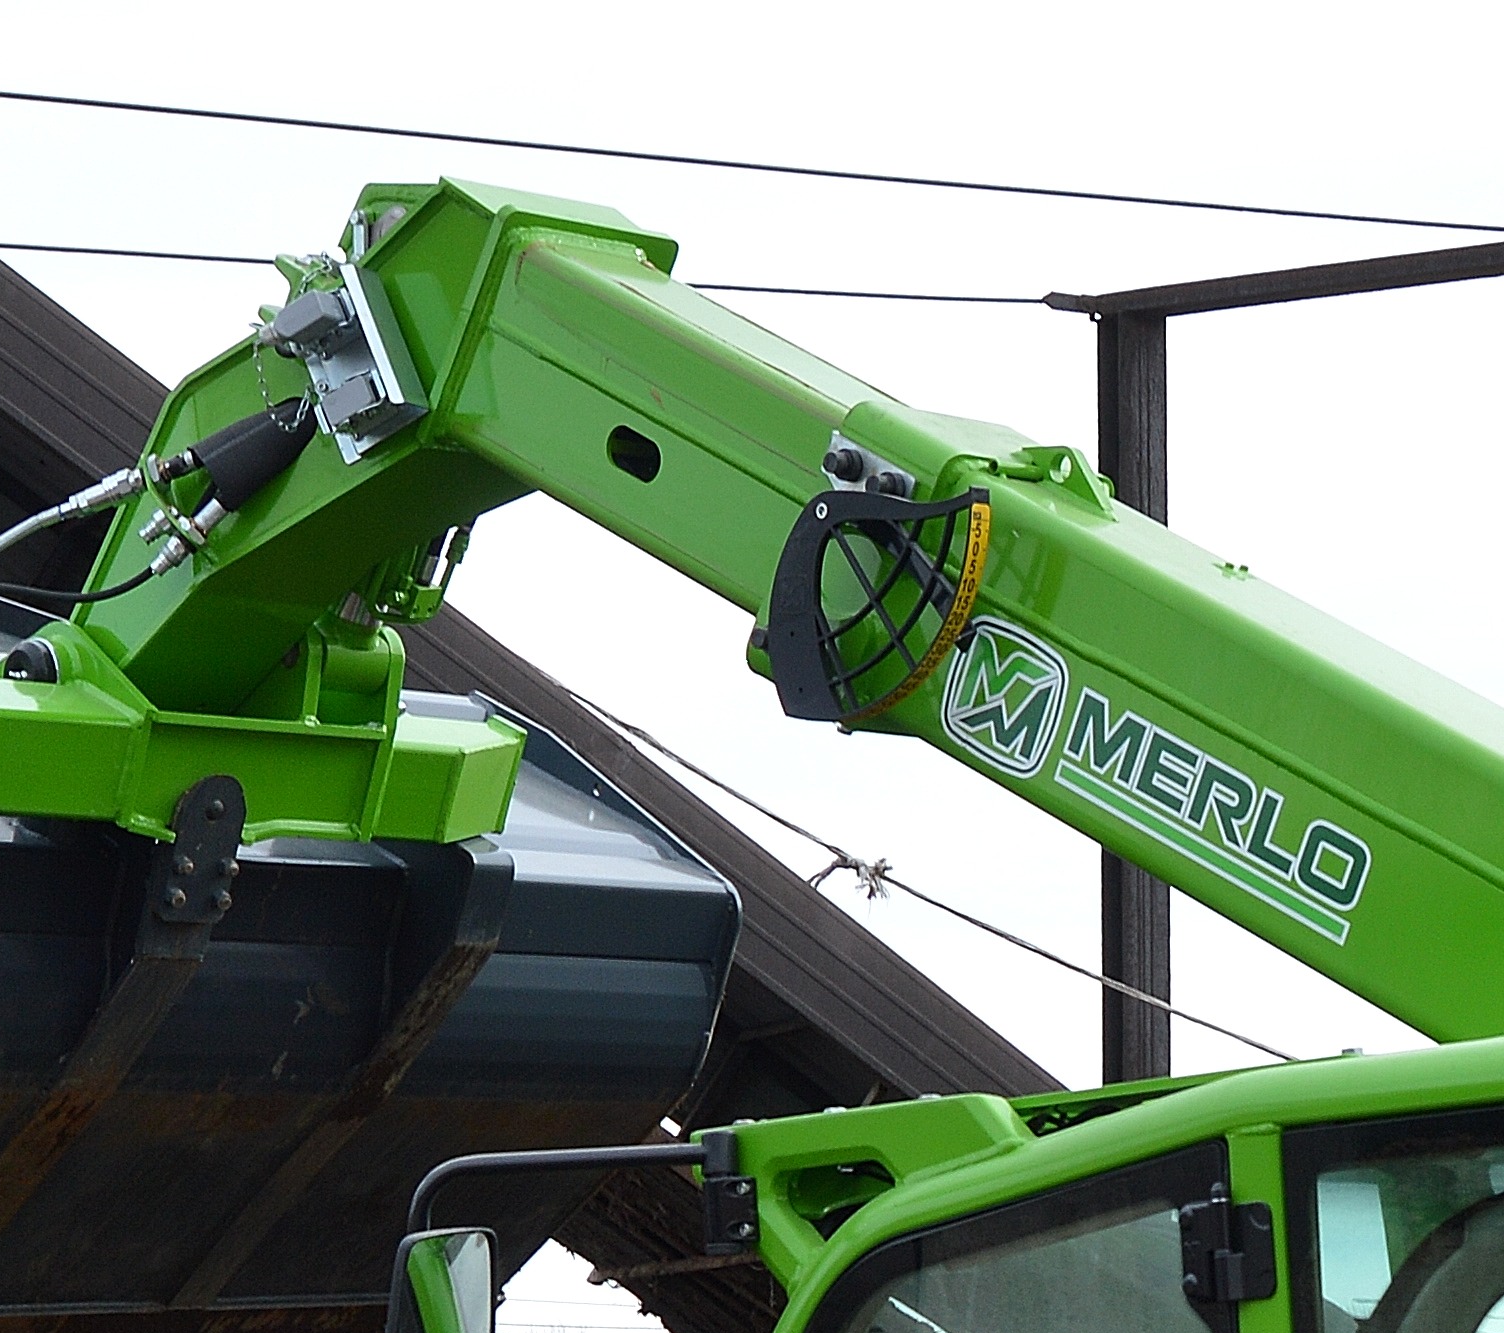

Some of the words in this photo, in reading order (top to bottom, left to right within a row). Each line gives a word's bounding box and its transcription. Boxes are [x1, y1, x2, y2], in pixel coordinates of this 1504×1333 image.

[974, 522, 982, 538] 5
[972, 541, 980, 557] 0
[968, 560, 976, 575] 5
[962, 578, 976, 593] 10
[1063, 686, 1371, 912] MERLO
